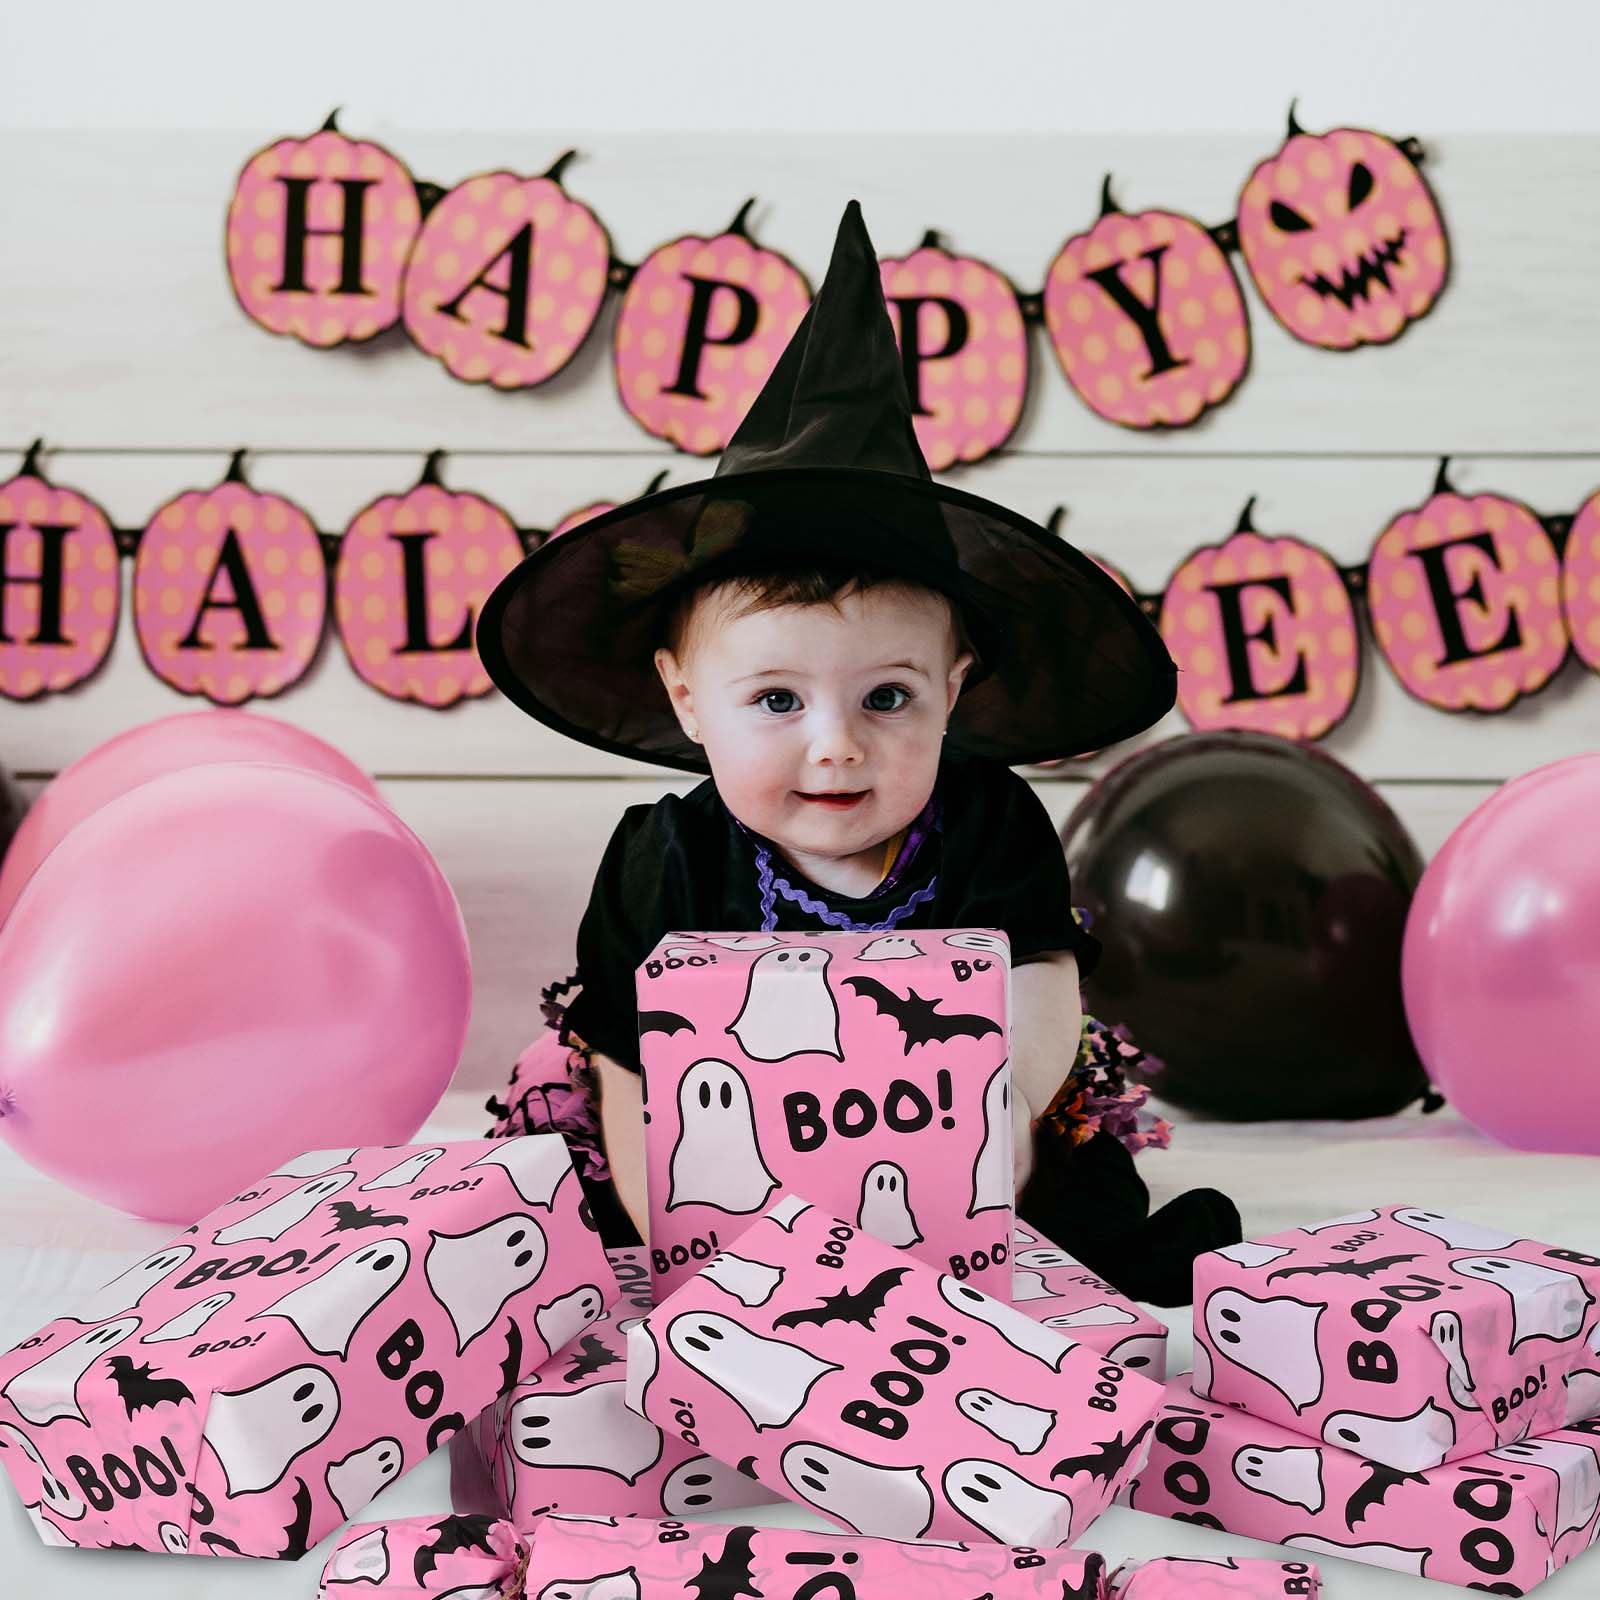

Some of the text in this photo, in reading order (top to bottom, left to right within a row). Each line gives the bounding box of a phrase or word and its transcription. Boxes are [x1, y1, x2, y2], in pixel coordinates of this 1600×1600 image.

[272, 174, 1190, 418] HAPPY
[645, 954, 718, 979] BOO!
[783, 1069, 956, 1152] BOO!
[409, 1177, 484, 1200] BOO!
[174, 1242, 340, 1289] BOO!
[652, 1231, 721, 1274] BOO!
[816, 1217, 857, 1269] BOO!
[948, 1233, 1011, 1281] BOO!
[1331, 1230, 1384, 1253] BOO!
[188, 1332, 267, 1358] BOO!
[1347, 1274, 1463, 1384] BOO!
[840, 1314, 967, 1440] BOO!
[1088, 1356, 1127, 1413] BOO!
[1491, 1364, 1547, 1424] BOO!
[66, 1436, 195, 1512] BOO!
